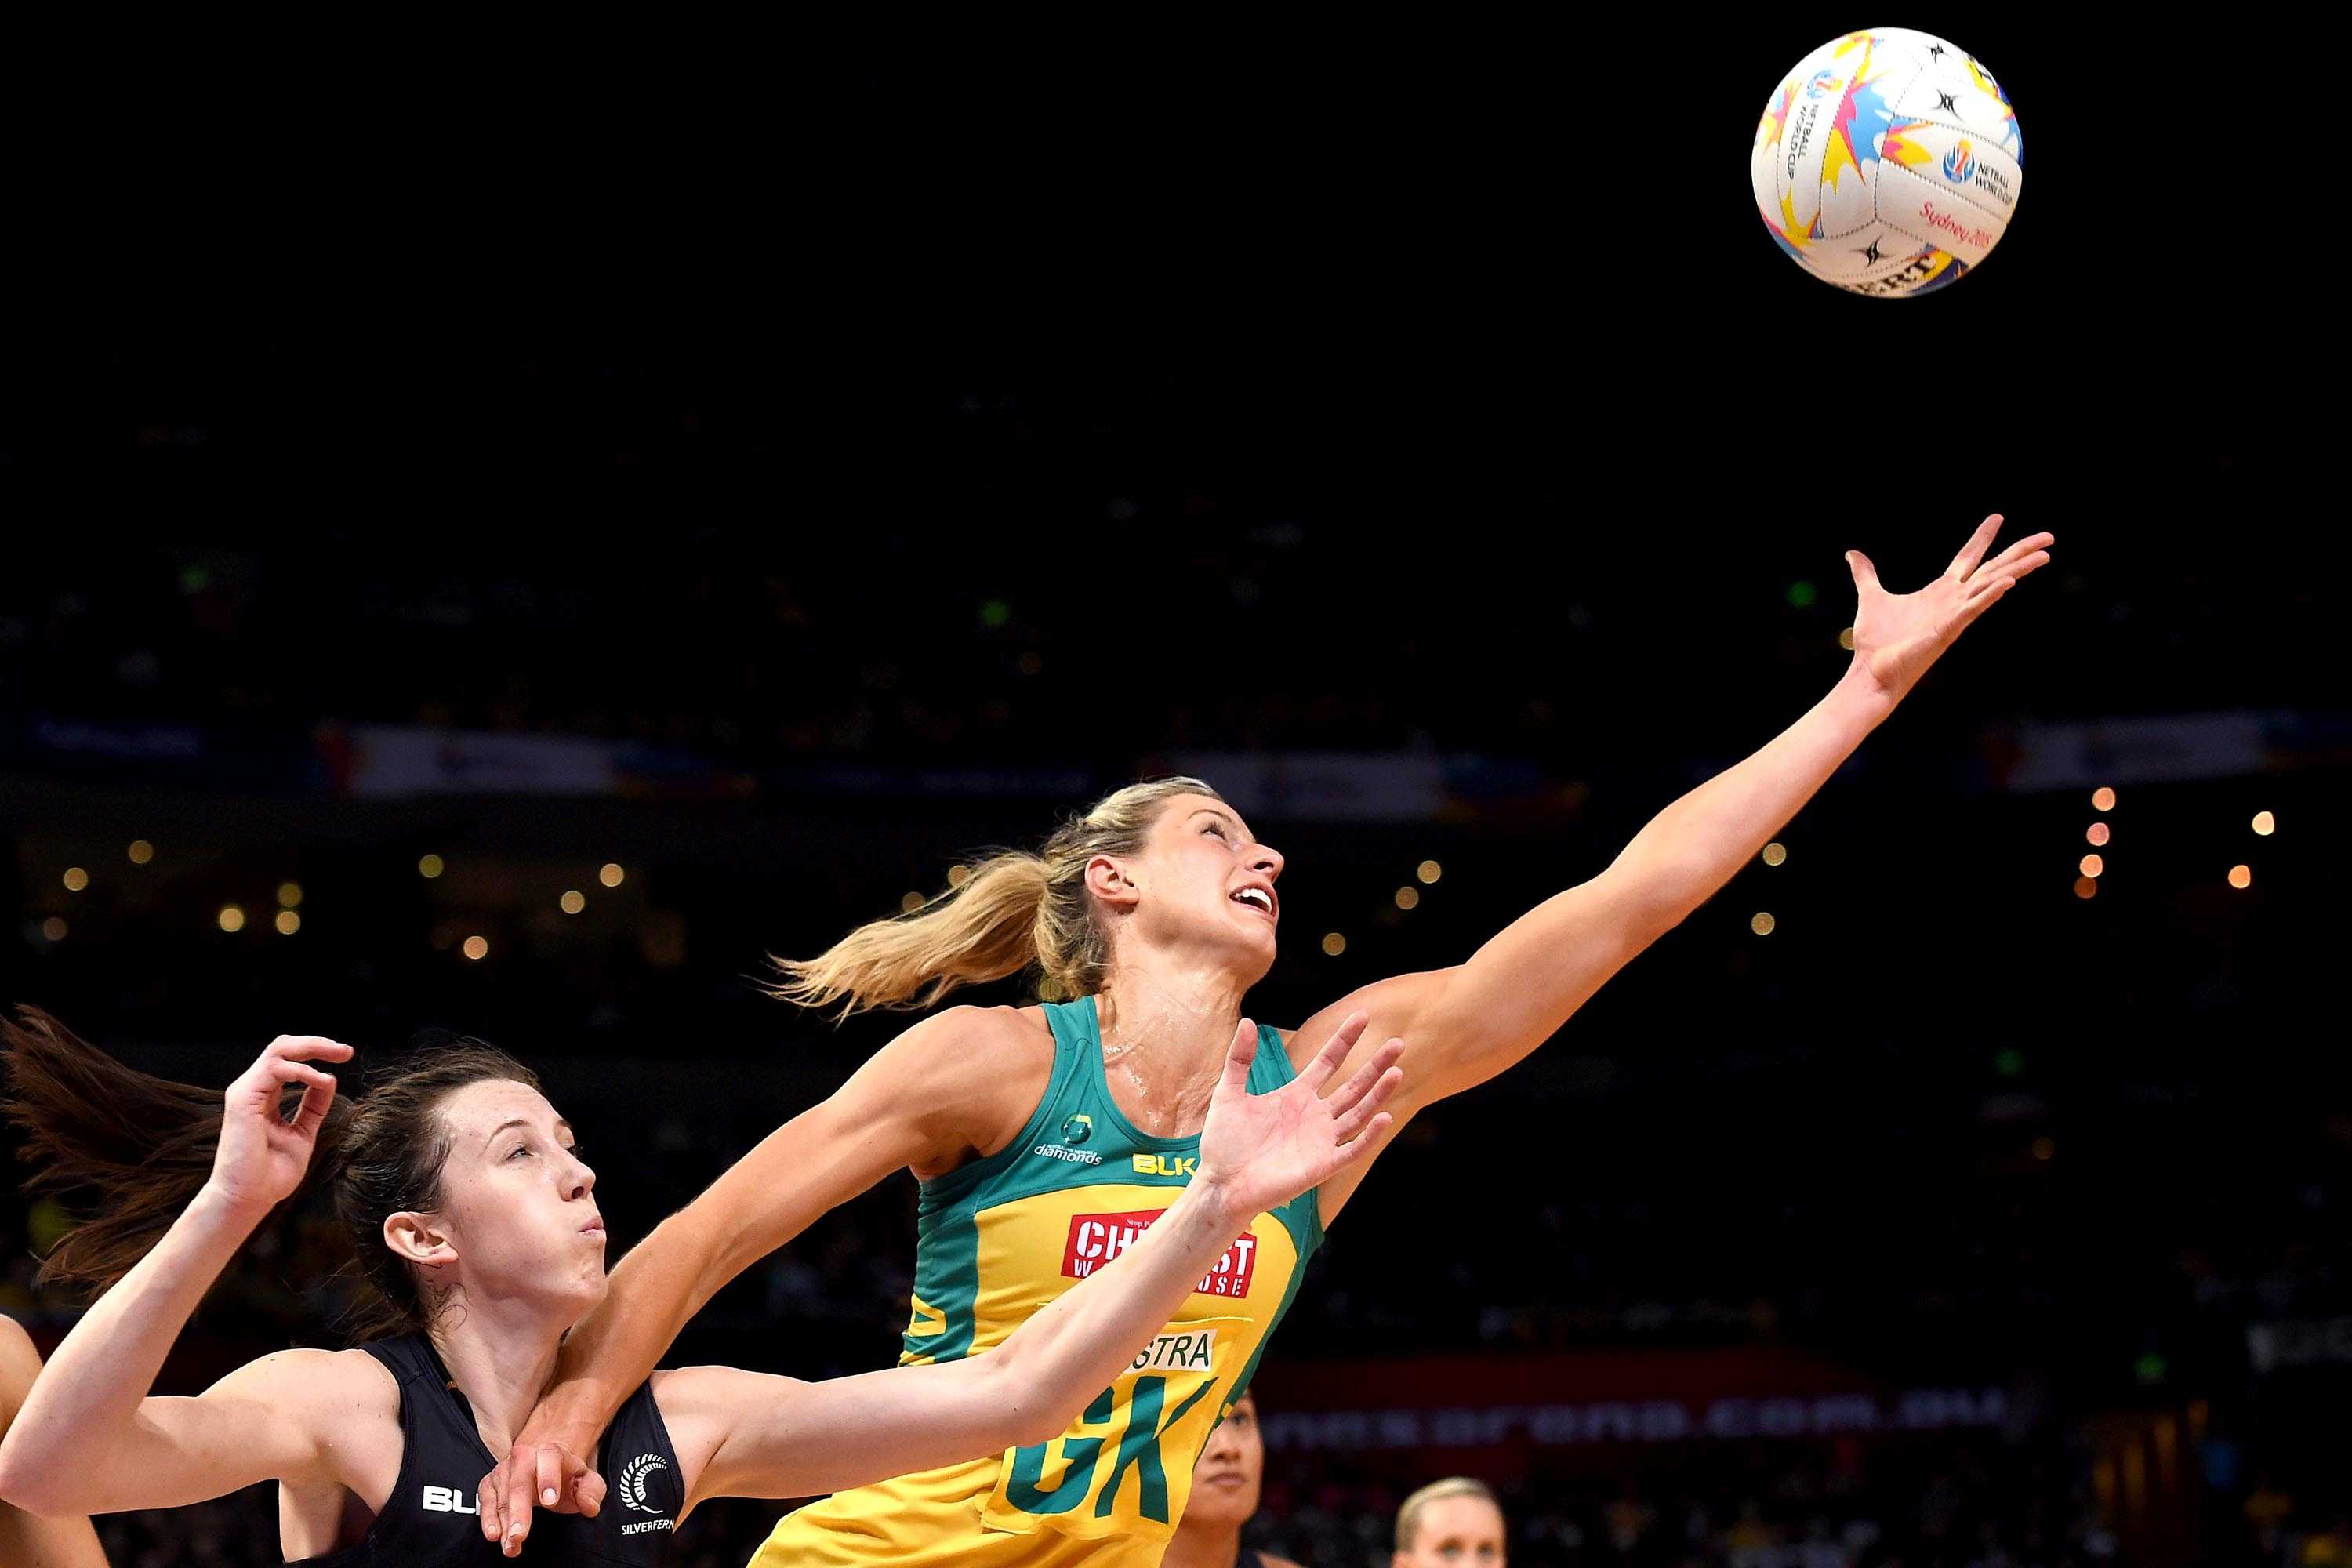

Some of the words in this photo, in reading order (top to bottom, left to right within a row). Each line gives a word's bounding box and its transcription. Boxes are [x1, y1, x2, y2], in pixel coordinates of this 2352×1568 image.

[1978, 162, 2009, 188] NETBALL
[1918, 201, 1969, 244] Sydney
[1034, 1144, 1102, 1165] diamonds
[1132, 1153, 1196, 1176] BLK
[1076, 1221, 1254, 1276] CHST
[1006, 1376, 1219, 1524] GK
[423, 1485, 481, 1515] BL
